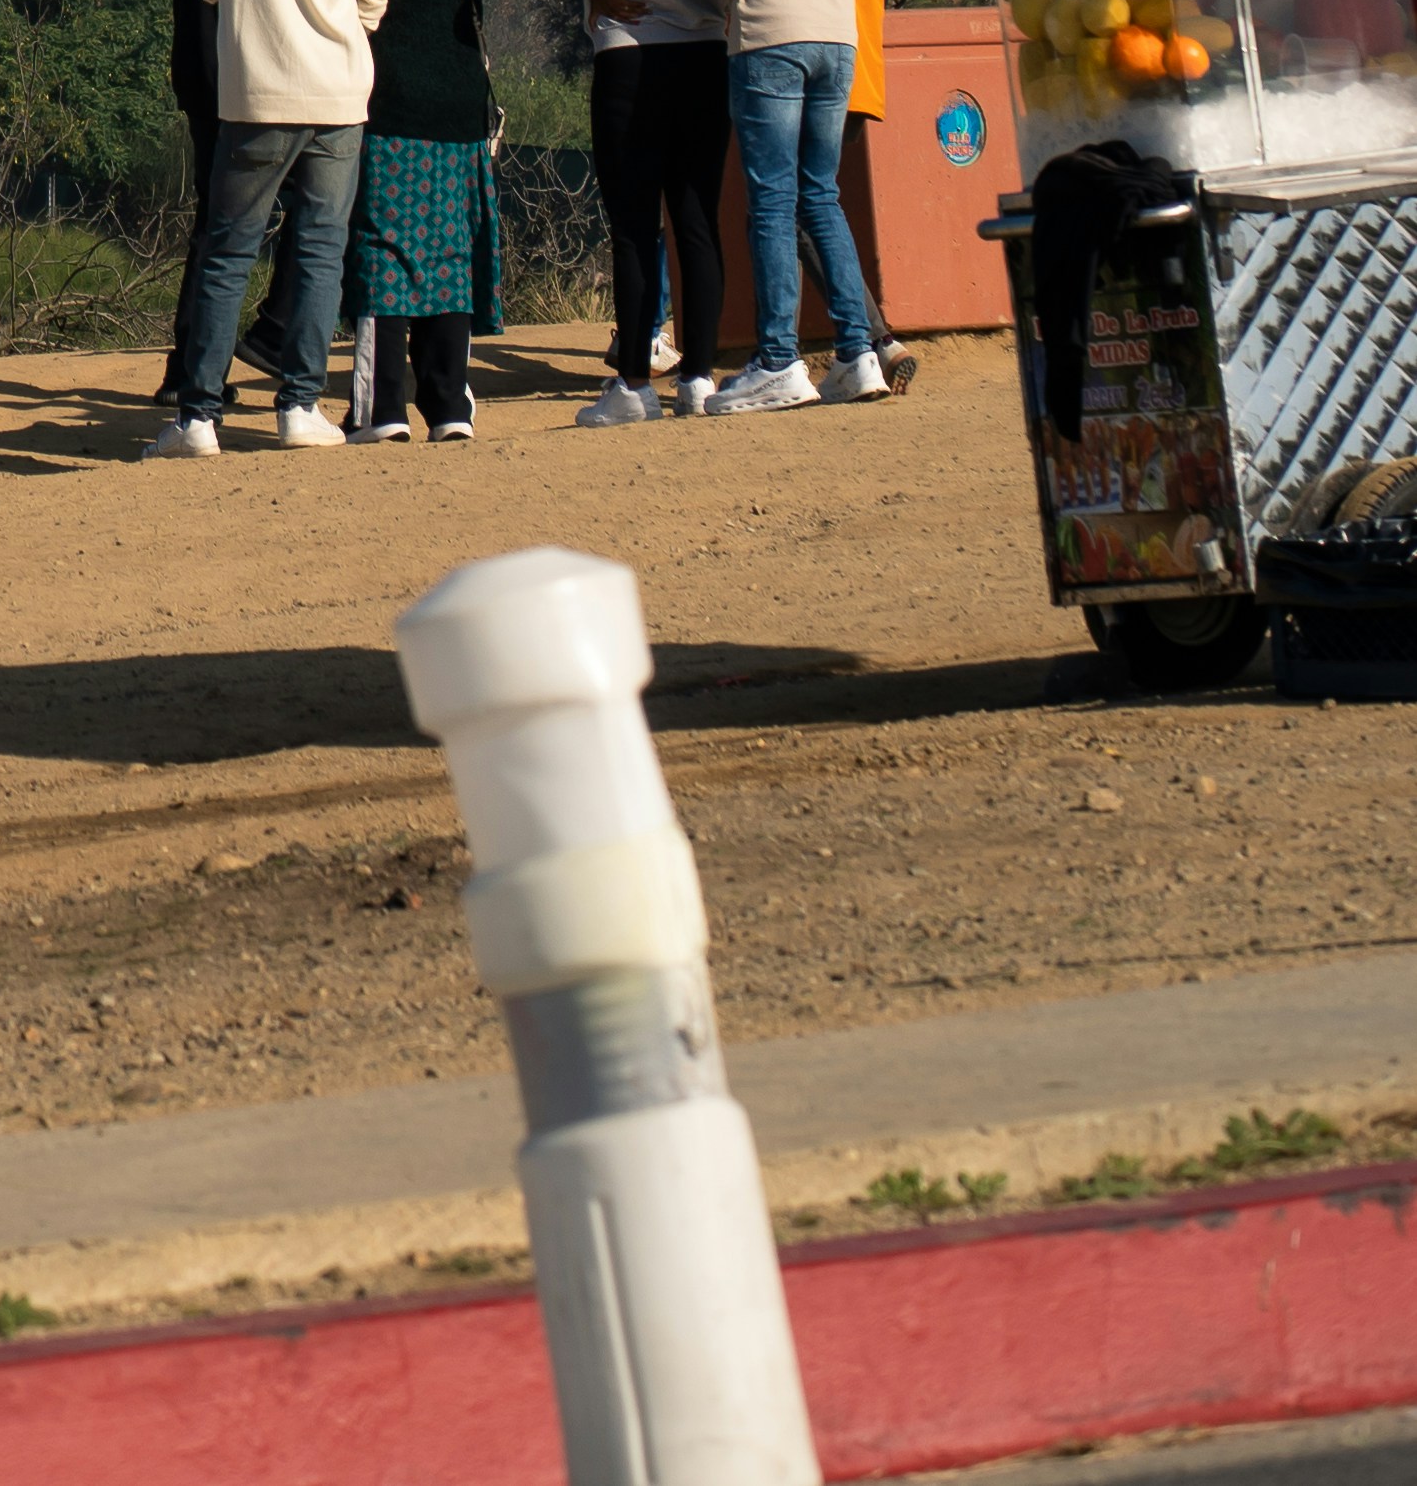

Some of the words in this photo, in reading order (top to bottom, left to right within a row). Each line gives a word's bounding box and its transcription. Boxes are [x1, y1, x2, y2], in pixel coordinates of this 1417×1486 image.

[1091, 311, 1120, 336] De
[1124, 309, 1149, 334] La
[1149, 306, 1200, 331] Fruta
[1088, 340, 1150, 367] MIDAS
